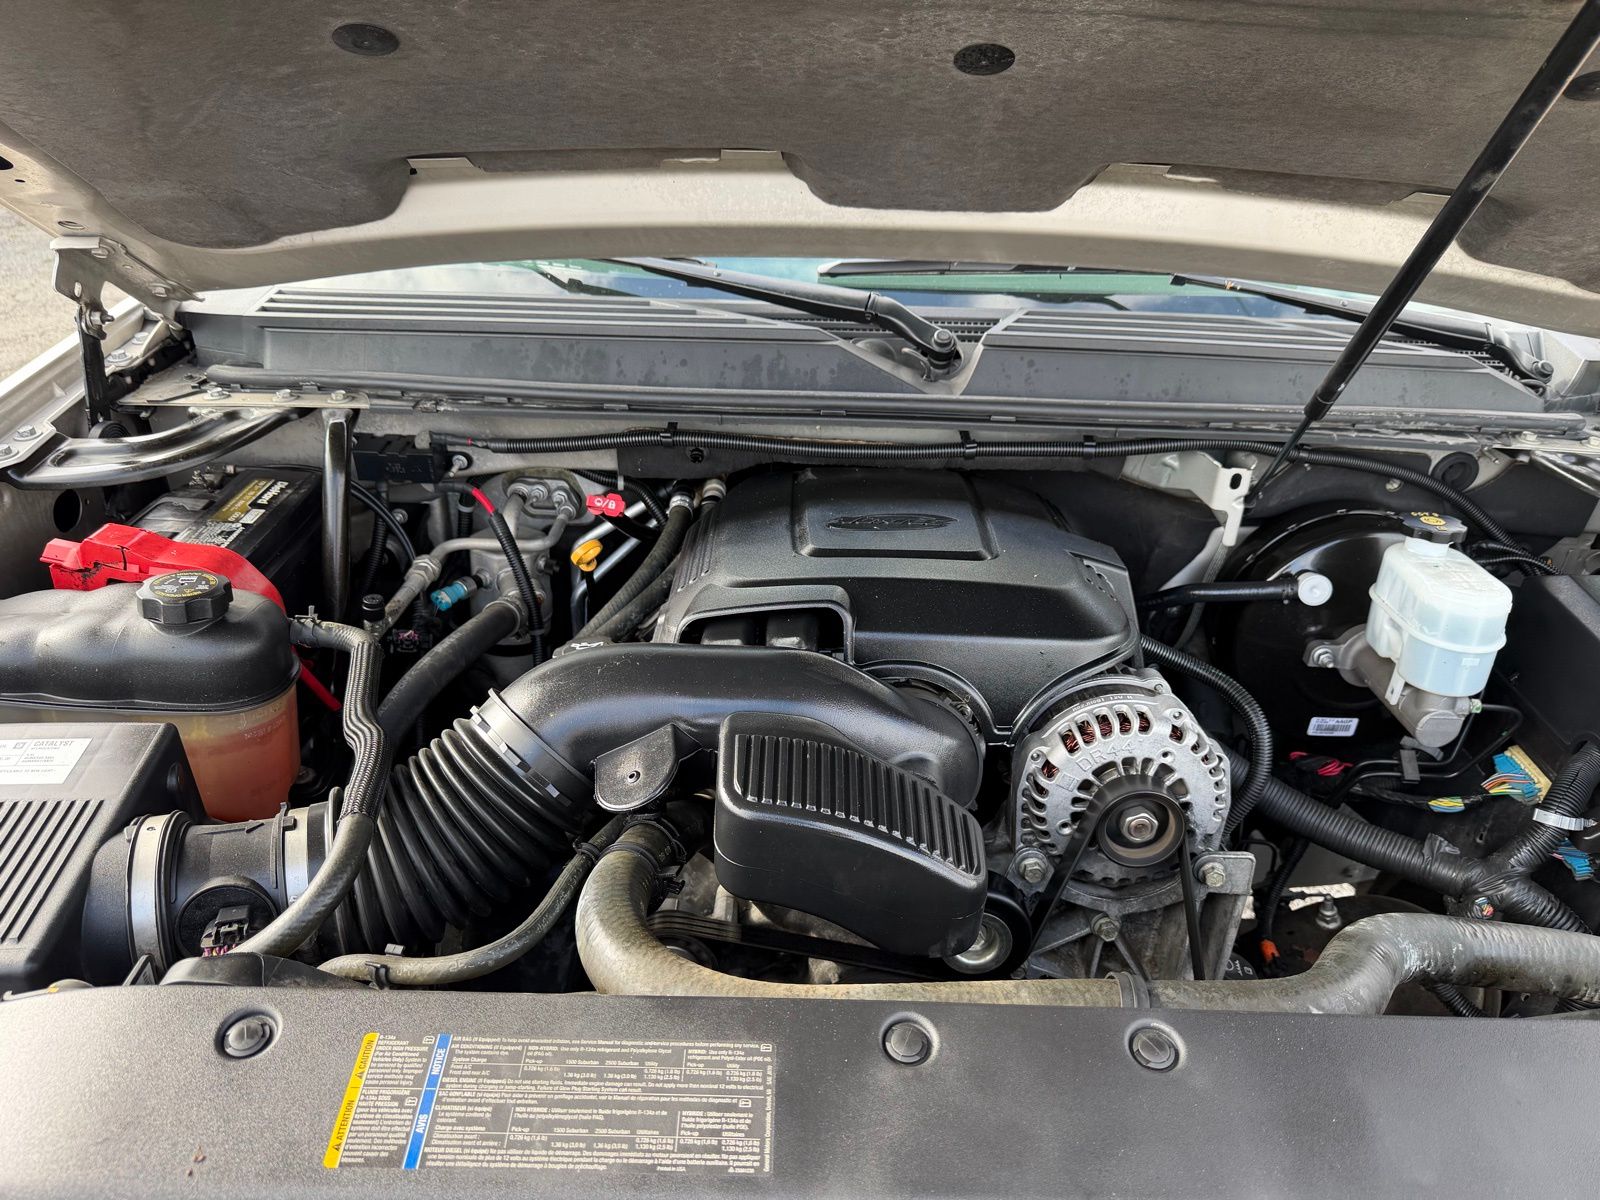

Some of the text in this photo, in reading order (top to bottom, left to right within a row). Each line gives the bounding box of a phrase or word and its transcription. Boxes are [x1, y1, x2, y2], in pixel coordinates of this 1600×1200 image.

[1076, 739, 1135, 772] DR44
[358, 1040, 374, 1069] CAUTION
[431, 1048, 446, 1076] NOTICE
[336, 1100, 355, 1140] ATTENTION
[416, 1114, 428, 1134] AVIS
